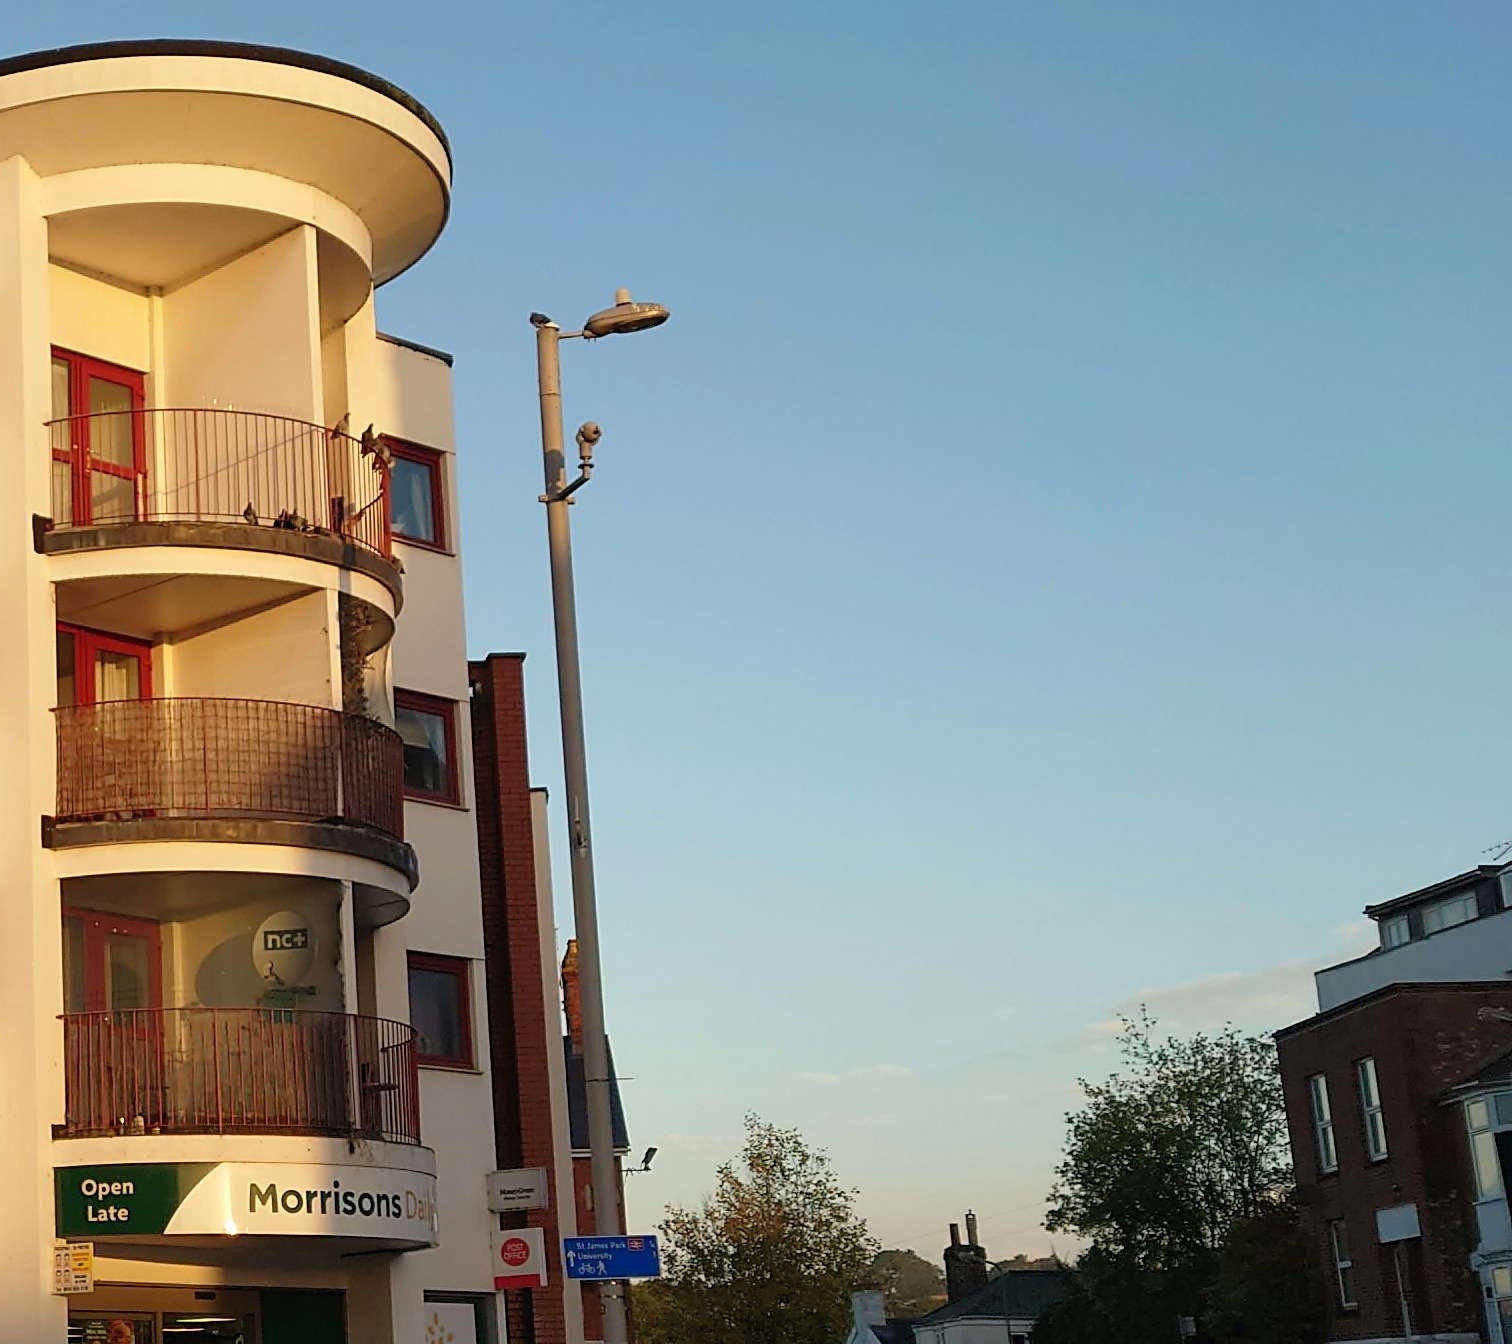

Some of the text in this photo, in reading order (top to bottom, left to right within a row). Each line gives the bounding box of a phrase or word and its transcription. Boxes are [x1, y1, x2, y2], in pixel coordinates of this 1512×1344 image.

[266, 931, 306, 949] nc+
[81, 1179, 135, 1201] Open
[249, 1180, 402, 1219] Morrisons
[88, 1205, 129, 1222] Late
[576, 1242, 585, 1250] St
[587, 1241, 609, 1250] James
[610, 1240, 626, 1249] Park
[577, 1252, 613, 1261] University
